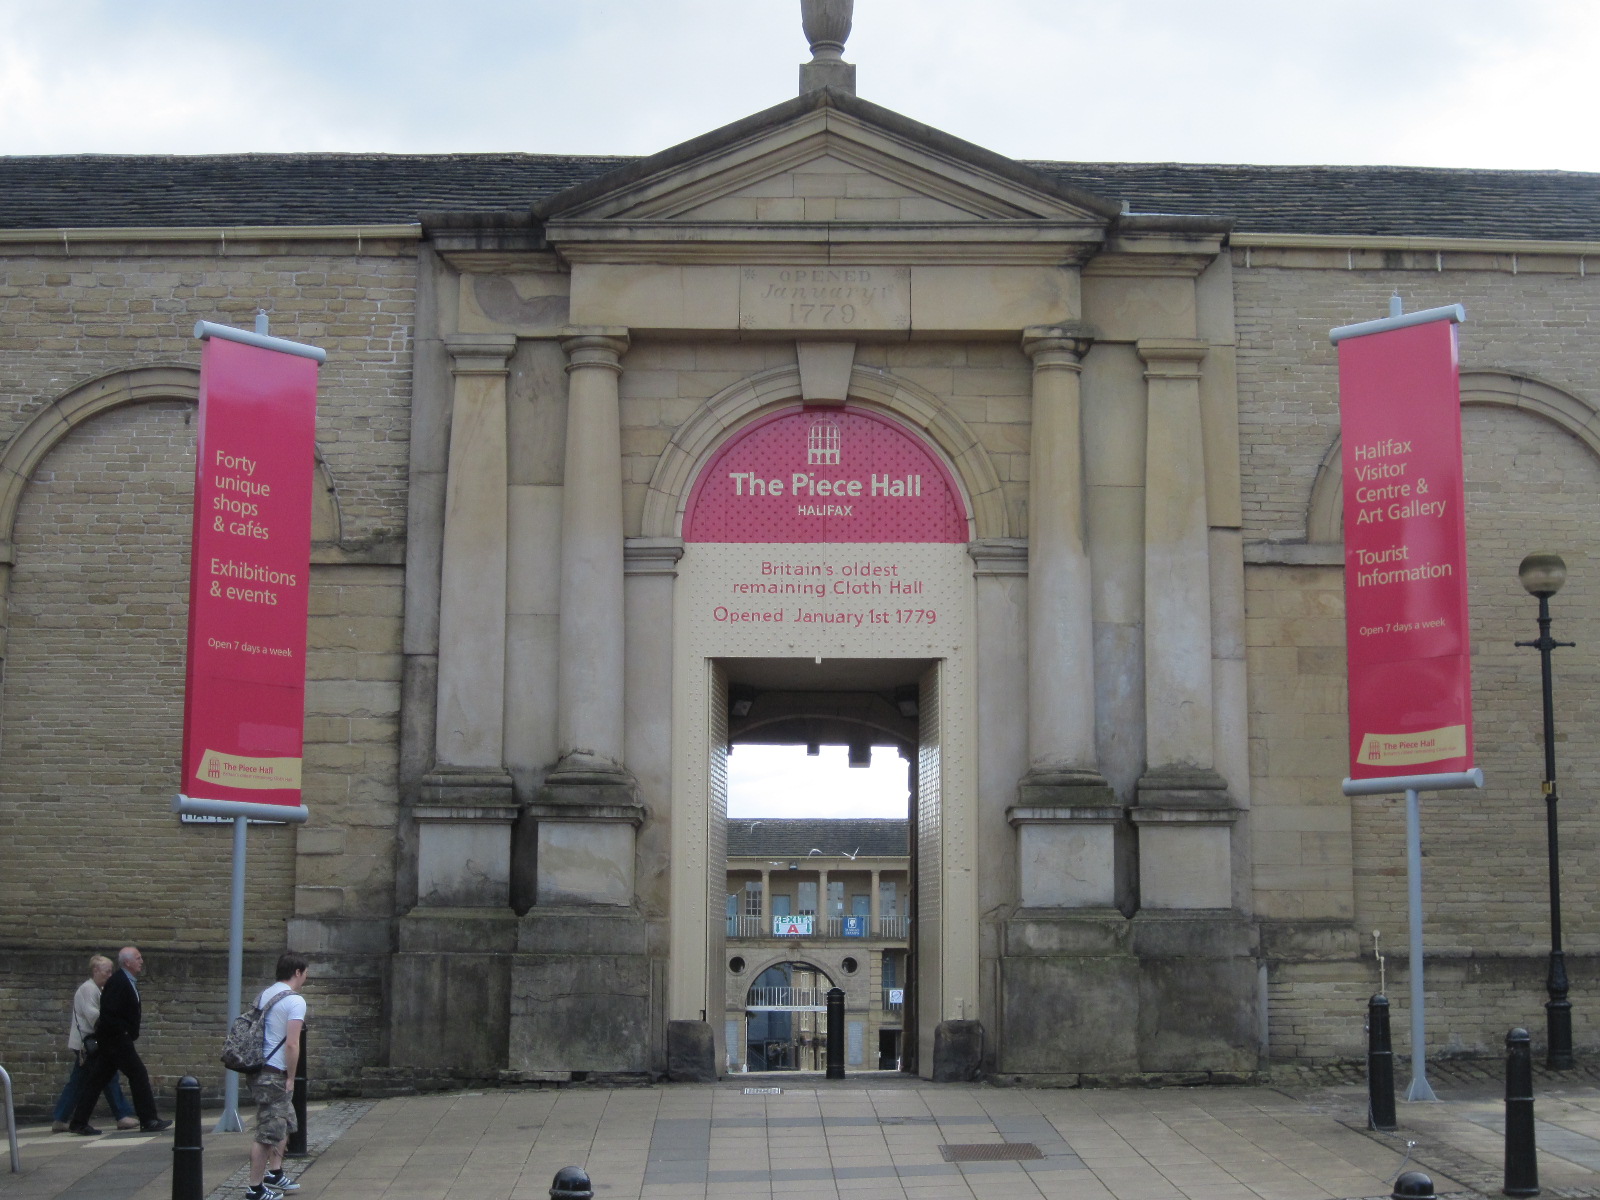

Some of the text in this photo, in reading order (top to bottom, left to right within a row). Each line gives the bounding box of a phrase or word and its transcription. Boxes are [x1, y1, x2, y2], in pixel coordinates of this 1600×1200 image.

[780, 270, 872, 283] OPENED
[761, 284, 877, 305] January
[1355, 439, 1412, 461] Halifax
[216, 450, 256, 476] Forty
[1355, 462, 1407, 482] Visitor
[215, 474, 270, 497] unique
[729, 472, 921, 497] The Piece Hall
[1356, 477, 1428, 503] Centre &
[213, 493, 258, 518] shops
[798, 505, 853, 516] HALIFAX
[1356, 499, 1446, 525] Art Gallery
[213, 515, 269, 540] & cafés
[1355, 544, 1409, 566] Tourist
[210, 557, 296, 587] Exhibitions
[761, 561, 899, 577] Britain's oldest
[1357, 562, 1452, 587] Information
[209, 580, 278, 605] & events
[733, 580, 924, 598] remaining Cloth Hall
[713, 606, 937, 628] Opened January 1st 1779
[1360, 625, 1384, 637] Open
[1385, 623, 1391, 632] 7
[1393, 622, 1413, 634] days
[1421, 617, 1446, 628] week
[207, 637, 293, 658] Open 7 days a week
[1383, 738, 1435, 750] The Piece Hall
[223, 762, 274, 774] The Piece Hall
[781, 916, 806, 924] EXIT
[787, 924, 799, 933] A
